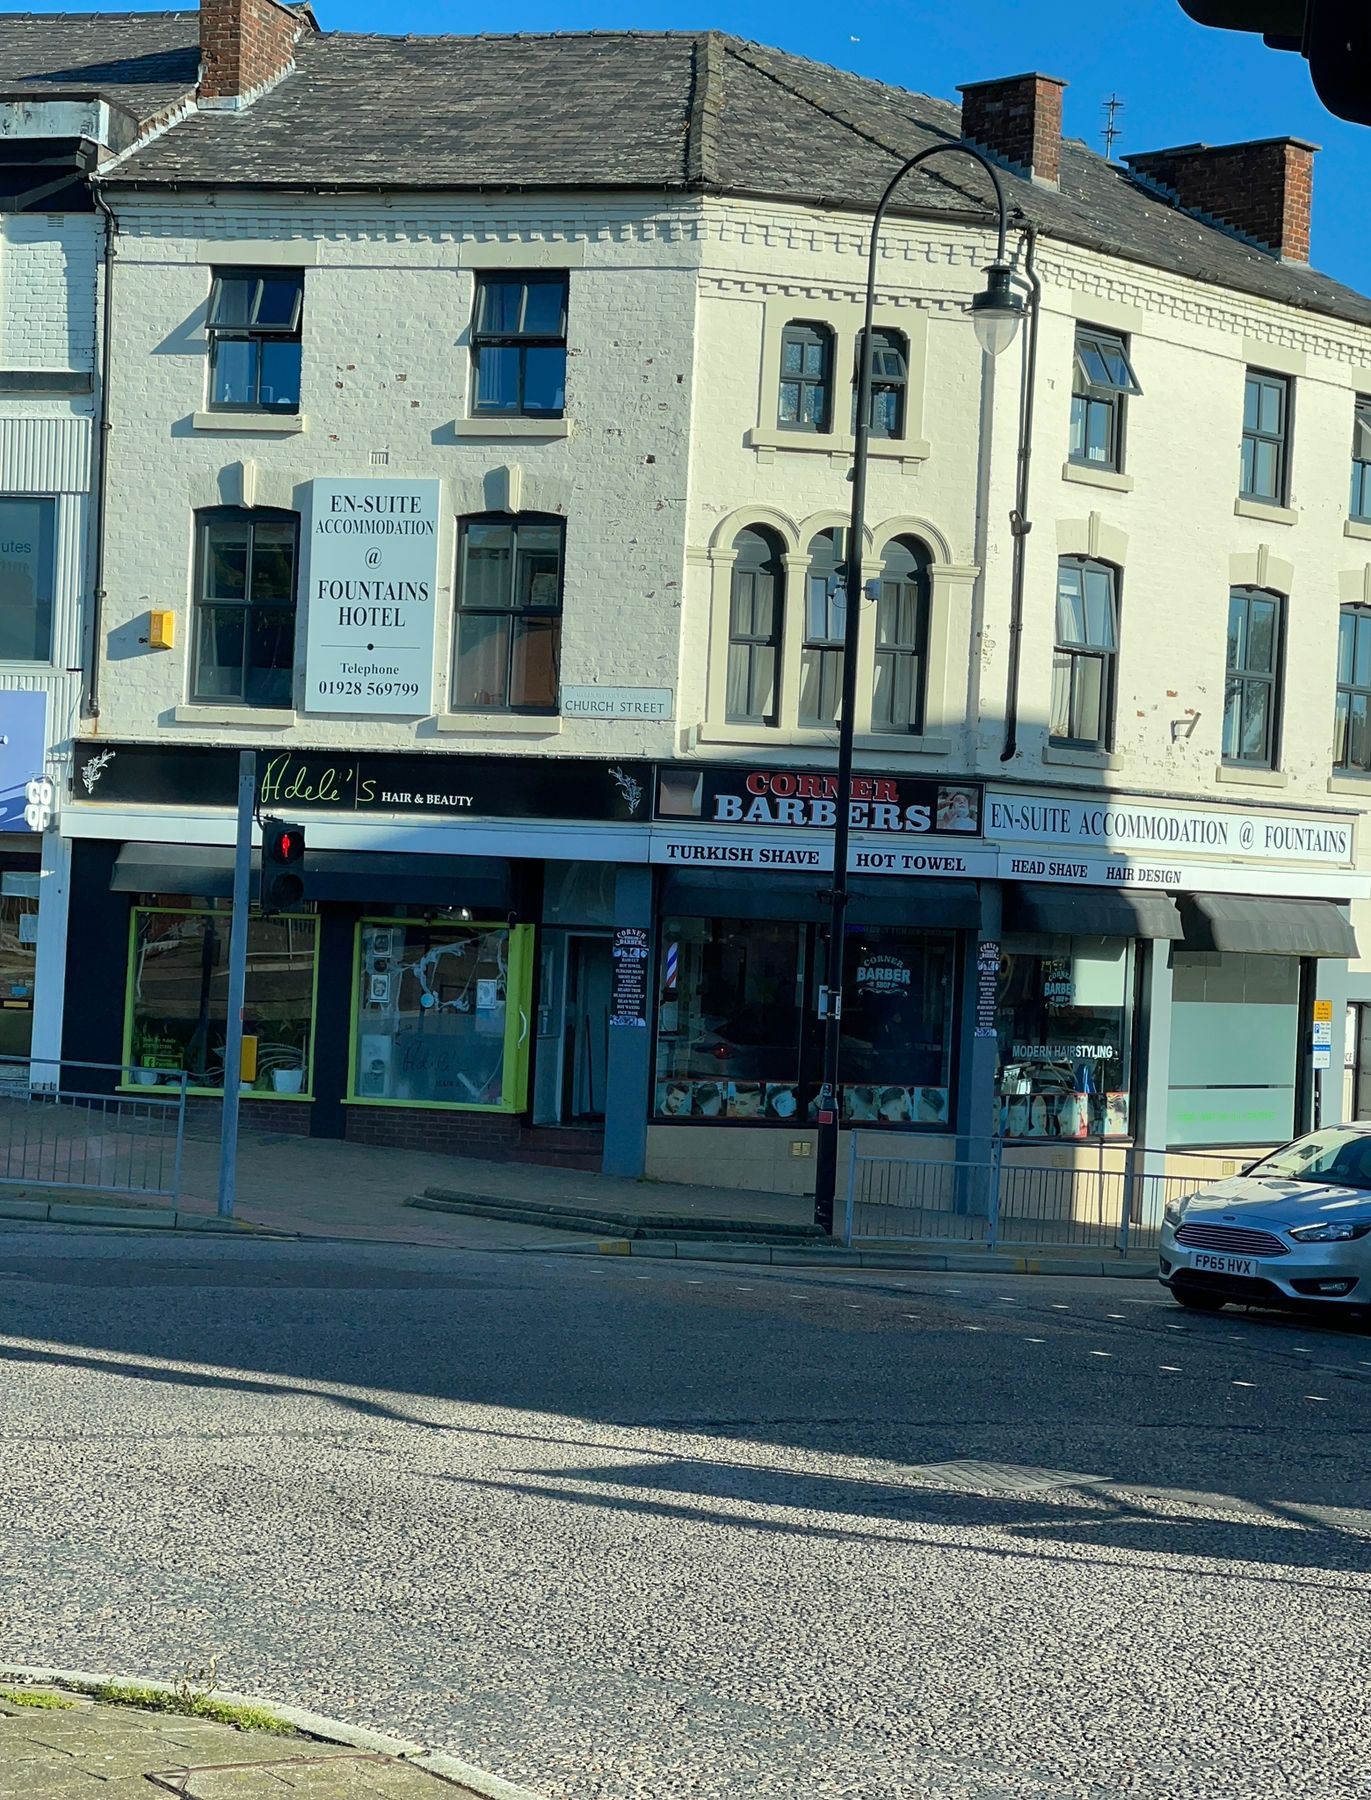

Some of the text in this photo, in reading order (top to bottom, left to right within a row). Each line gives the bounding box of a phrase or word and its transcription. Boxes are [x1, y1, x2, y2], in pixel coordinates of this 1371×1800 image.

[330, 495, 422, 514] EN-SUITE
[315, 518, 435, 536] ACCOMMODATION
[365, 546, 382, 570] @
[317, 580, 429, 602] FOUNTAINS
[338, 606, 406, 627] HOTEL
[340, 662, 400, 677] Telephone
[318, 681, 419, 697] 01928 569799
[565, 700, 665, 714] CHURCH STREET
[745, 771, 900, 803] CORNER
[381, 792, 411, 803] HAIR
[414, 794, 424, 804] &
[426, 794, 474, 807] BEAUTY
[712, 794, 932, 833] BARBERS
[991, 803, 1347, 854] EN-SUITE ACCOMMODATION @ FOUNTAINS
[667, 844, 966, 872] TURKISH SHAVE HOT TOWEL
[1011, 859, 1182, 884] HEAD SHAVE HAIR DESIGN
[863, 955, 904, 968] CORNER
[856, 966, 911, 985] BARBER
[1012, 1045, 1114, 1059] MODERN HAIRSTYLING
[1195, 1254, 1252, 1275] FP65 HVX
